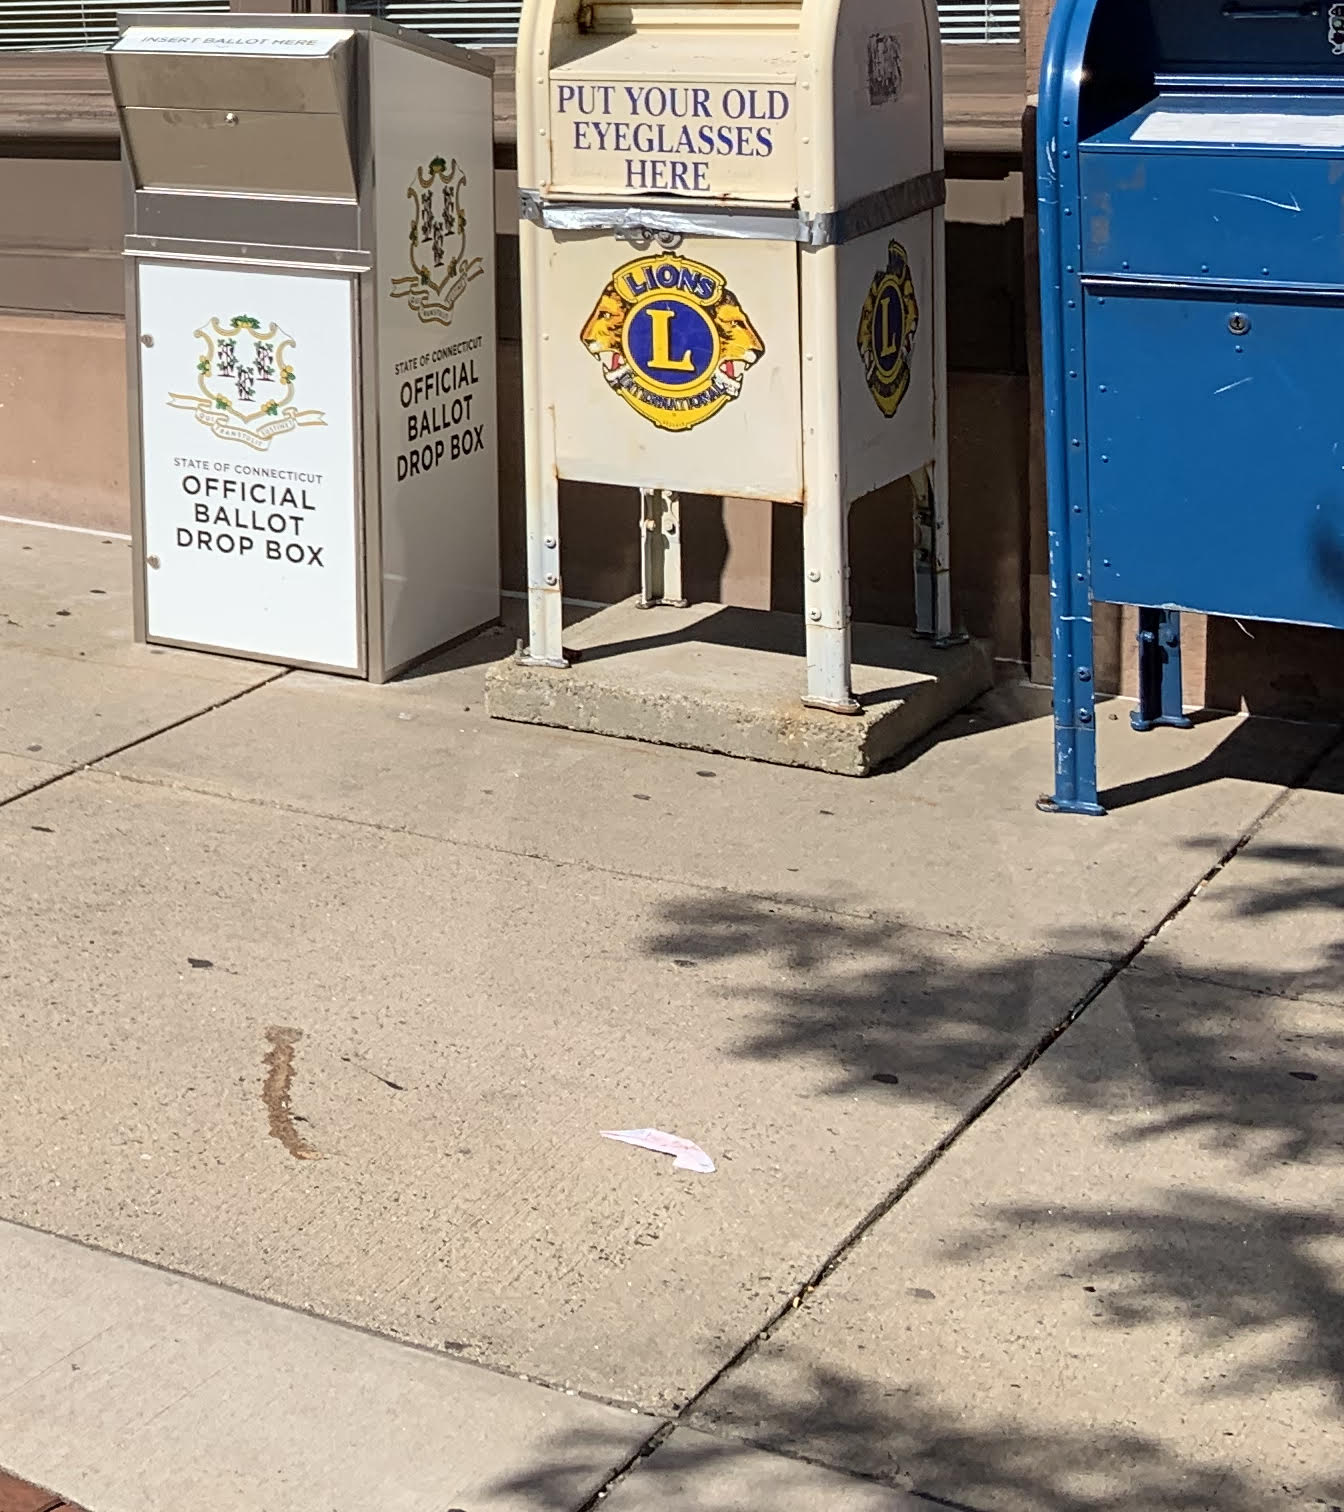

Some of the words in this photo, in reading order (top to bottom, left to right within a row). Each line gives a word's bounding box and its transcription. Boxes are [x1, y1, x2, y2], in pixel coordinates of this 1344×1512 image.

[140, 35, 198, 45] INSERT
[202, 37, 268, 46] BALLOT
[271, 38, 319, 47] HERE
[557, 85, 616, 115] PUT
[623, 86, 713, 118] YOUR
[722, 88, 790, 120] OLD
[573, 120, 774, 158] EYEGLASSES
[624, 158, 711, 192] HERE
[623, 263, 716, 300] LIONS
[645, 308, 696, 372] L
[880, 297, 897, 357] L
[395, 356, 418, 376] STATE
[419, 353, 430, 367] OF
[431, 336, 483, 363] CONNECTICUT
[400, 359, 479, 409] OFFICIAL
[408, 394, 473, 442] BALLOT
[173, 457, 210, 470] STATE
[214, 462, 230, 472] OF
[234, 464, 324, 484] CONNECTICUT
[397, 440, 445, 482] DROP
[451, 424, 485, 461] BOX
[182, 475, 317, 511] OFFICIAL
[194, 502, 305, 536] BALLOT
[176, 526, 254, 556] DROP
[266, 539, 325, 568] BOX
